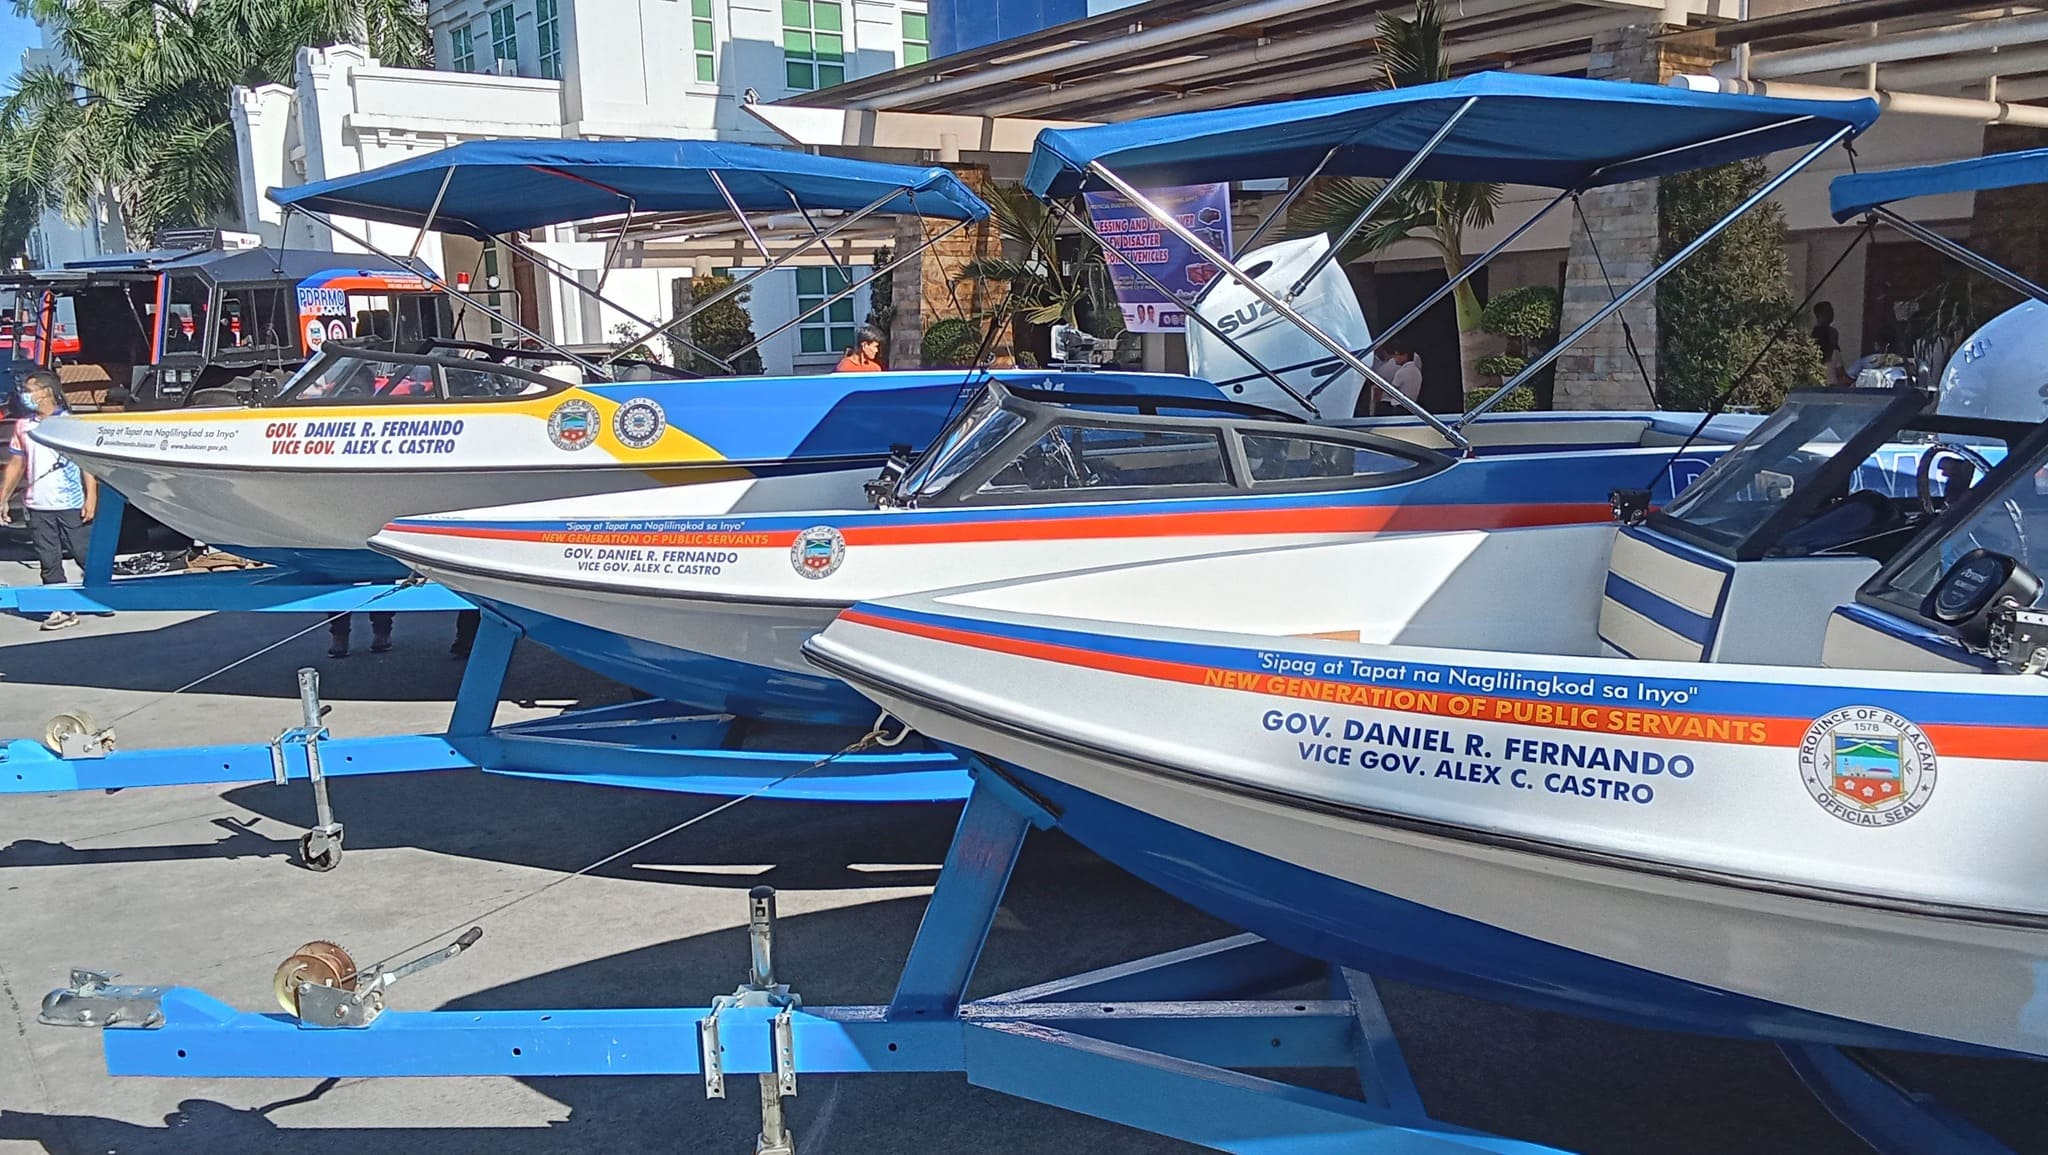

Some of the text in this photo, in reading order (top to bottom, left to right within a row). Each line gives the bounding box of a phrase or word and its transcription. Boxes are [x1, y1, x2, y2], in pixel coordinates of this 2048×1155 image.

[1095, 220, 1128, 233] LESSING
[1130, 217, 1147, 231] AND
[1123, 233, 1161, 248] DISASTER
[1132, 248, 1169, 263] VEHICLES
[265, 419, 465, 438] GOV. DANIEL R. FERNANDO
[271, 439, 456, 455] VICE GOV. ALEX C. CASTRO
[593, 522, 603, 530] at
[605, 521, 628, 532] Tapat
[644, 520, 704, 532] Naglilingkod
[541, 533, 769, 545] NEW GENERATION OF PUBLIC SERVANTS
[564, 548, 738, 564] GOV. DANIEL R. FERNANDO
[578, 561, 721, 576] VICE GOV. ALEX C. CASTRO
[1257, 651, 1699, 707] "Sipag at Tapat na Naglilingkod sa Inyo"
[1204, 669, 1768, 743] NEW GENERATION OF PUBLIC SERVANTS
[1854, 722, 1880, 732] 1578
[1262, 710, 1695, 780] GOV. DANIEL R. FERNANDO
[1802, 709, 1934, 772] PROVINCE OF BULACAN
[1298, 741, 1655, 804] VICE GOV. ALEX C. CASTRO
[1817, 792, 1921, 825] OFFICIAL SEAL
